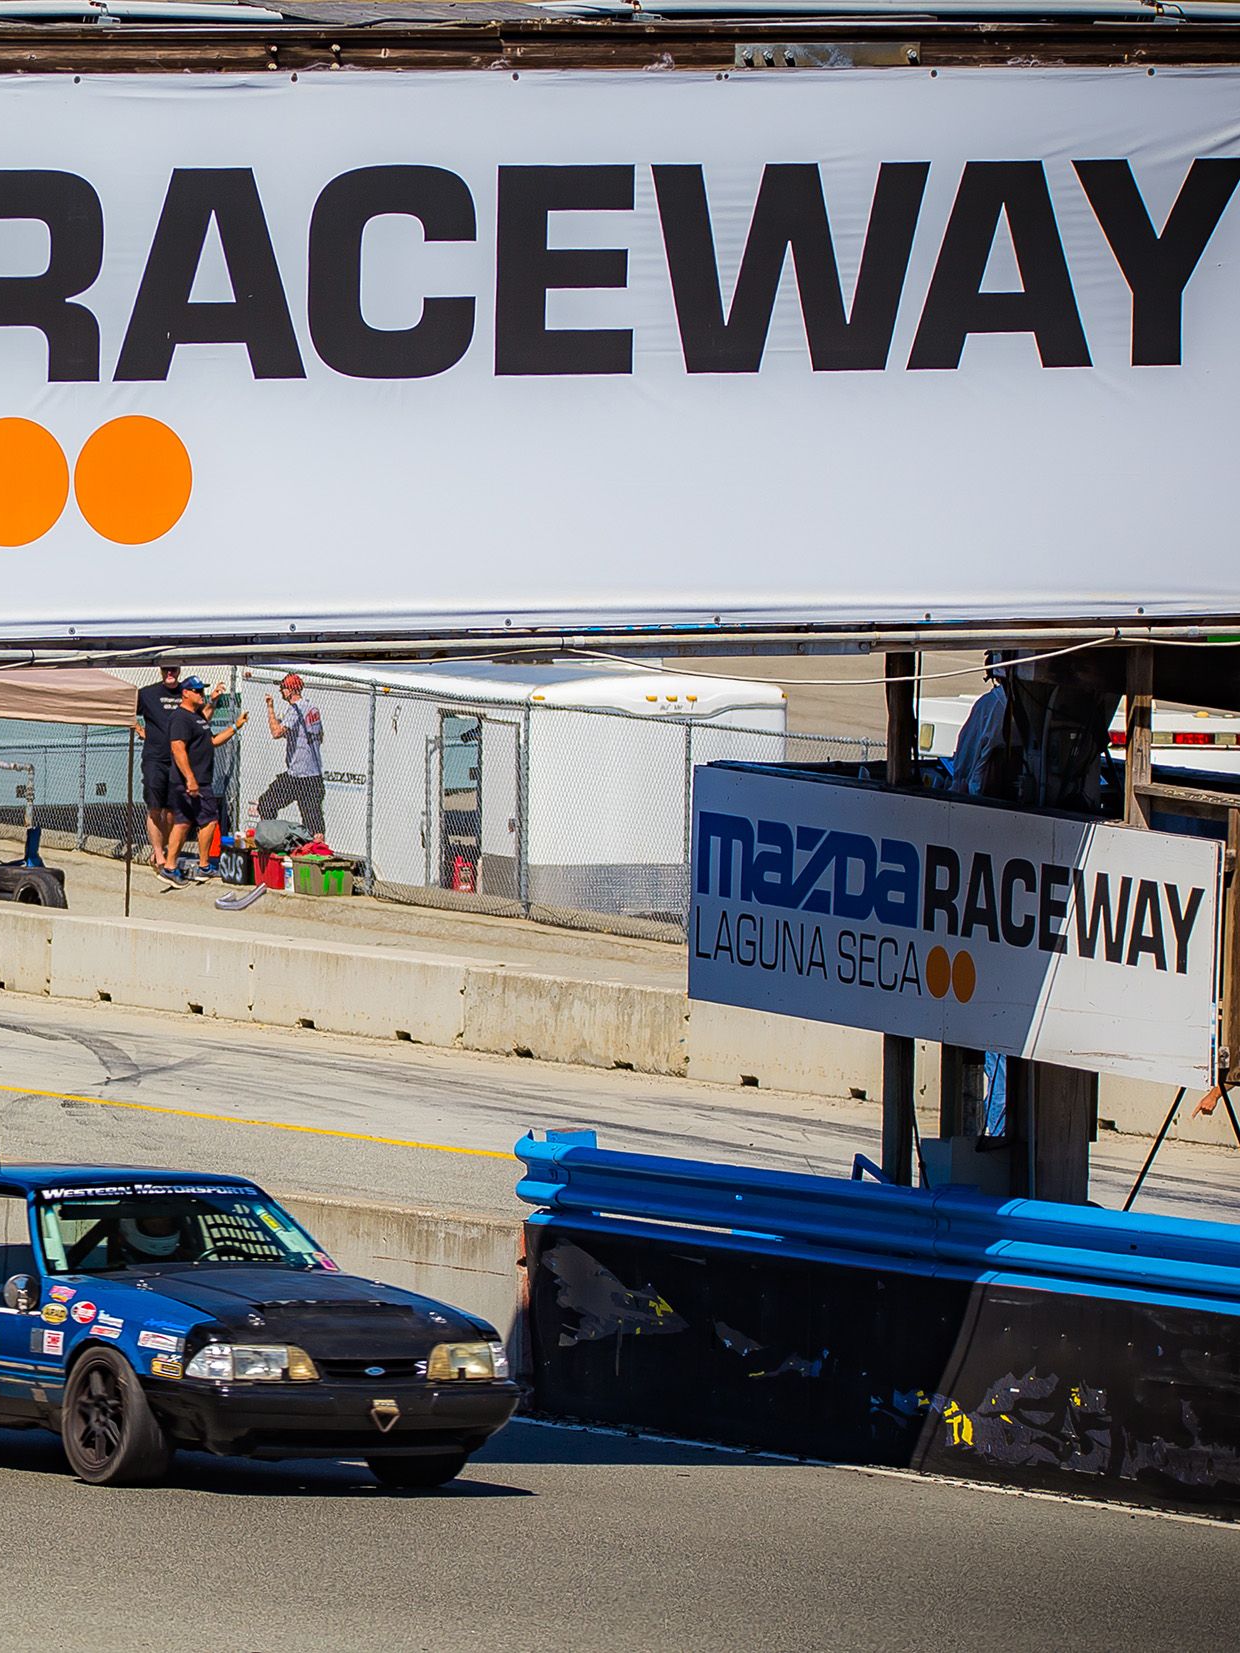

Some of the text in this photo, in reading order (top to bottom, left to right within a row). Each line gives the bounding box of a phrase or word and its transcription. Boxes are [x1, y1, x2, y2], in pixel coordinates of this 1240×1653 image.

[695, 905, 922, 996] LAGUNA SECA
[923, 844, 1206, 975] RACEWAY
